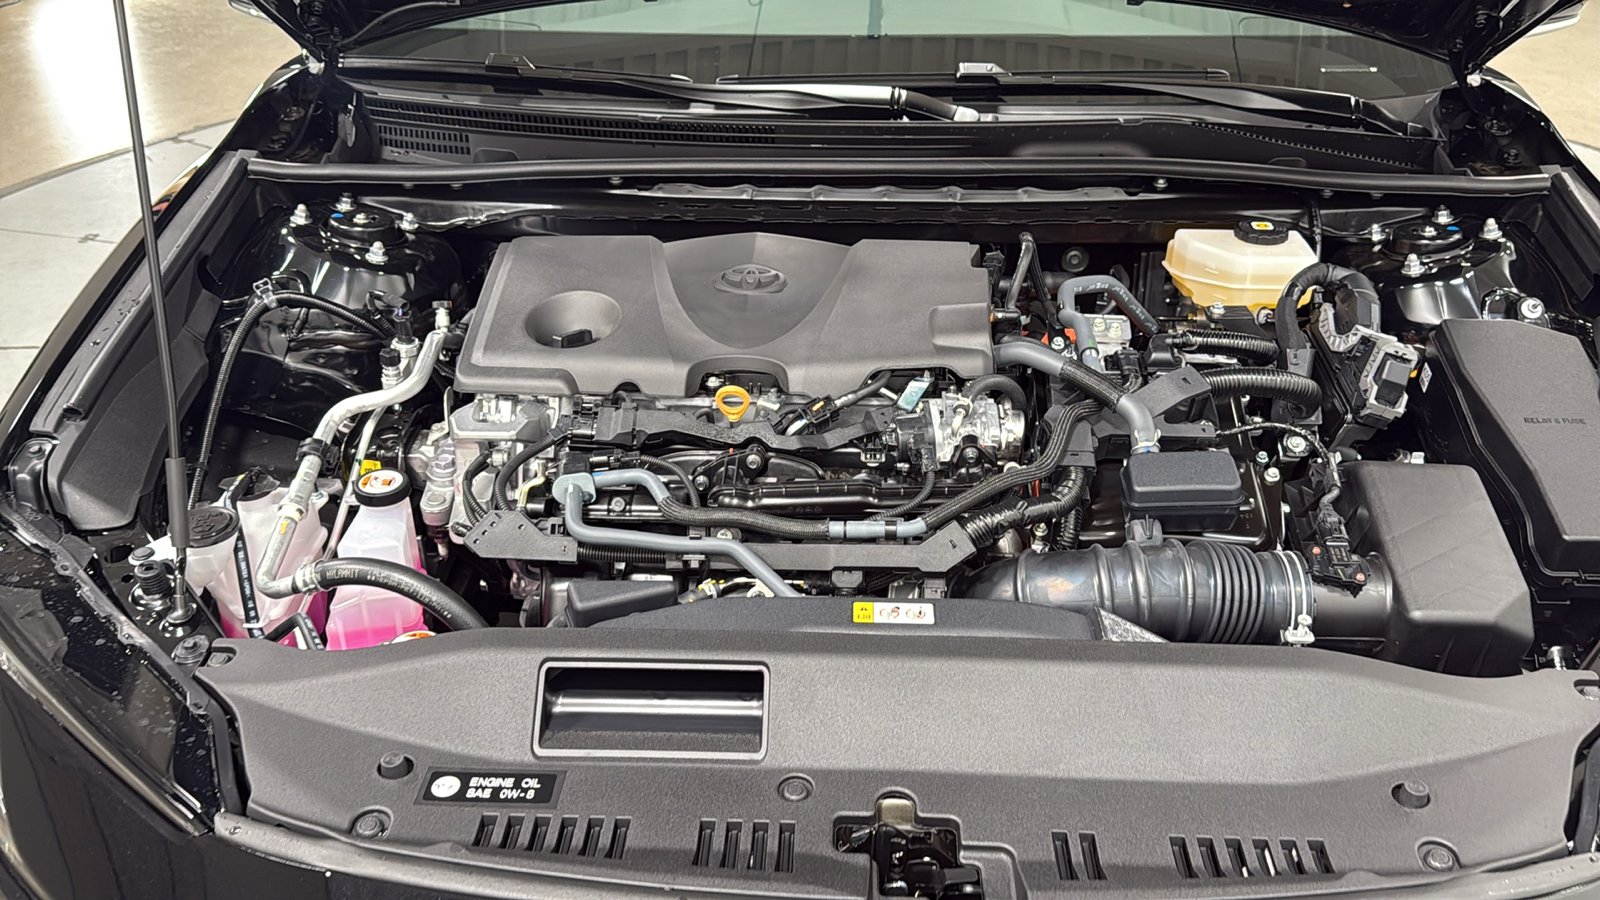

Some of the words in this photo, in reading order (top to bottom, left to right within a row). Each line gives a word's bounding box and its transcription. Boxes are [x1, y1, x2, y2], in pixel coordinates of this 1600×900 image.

[469, 777, 515, 787] ENGINE
[521, 778, 541, 788] OIL
[466, 788, 492, 798] SAE
[499, 789, 535, 799] 0W-8
